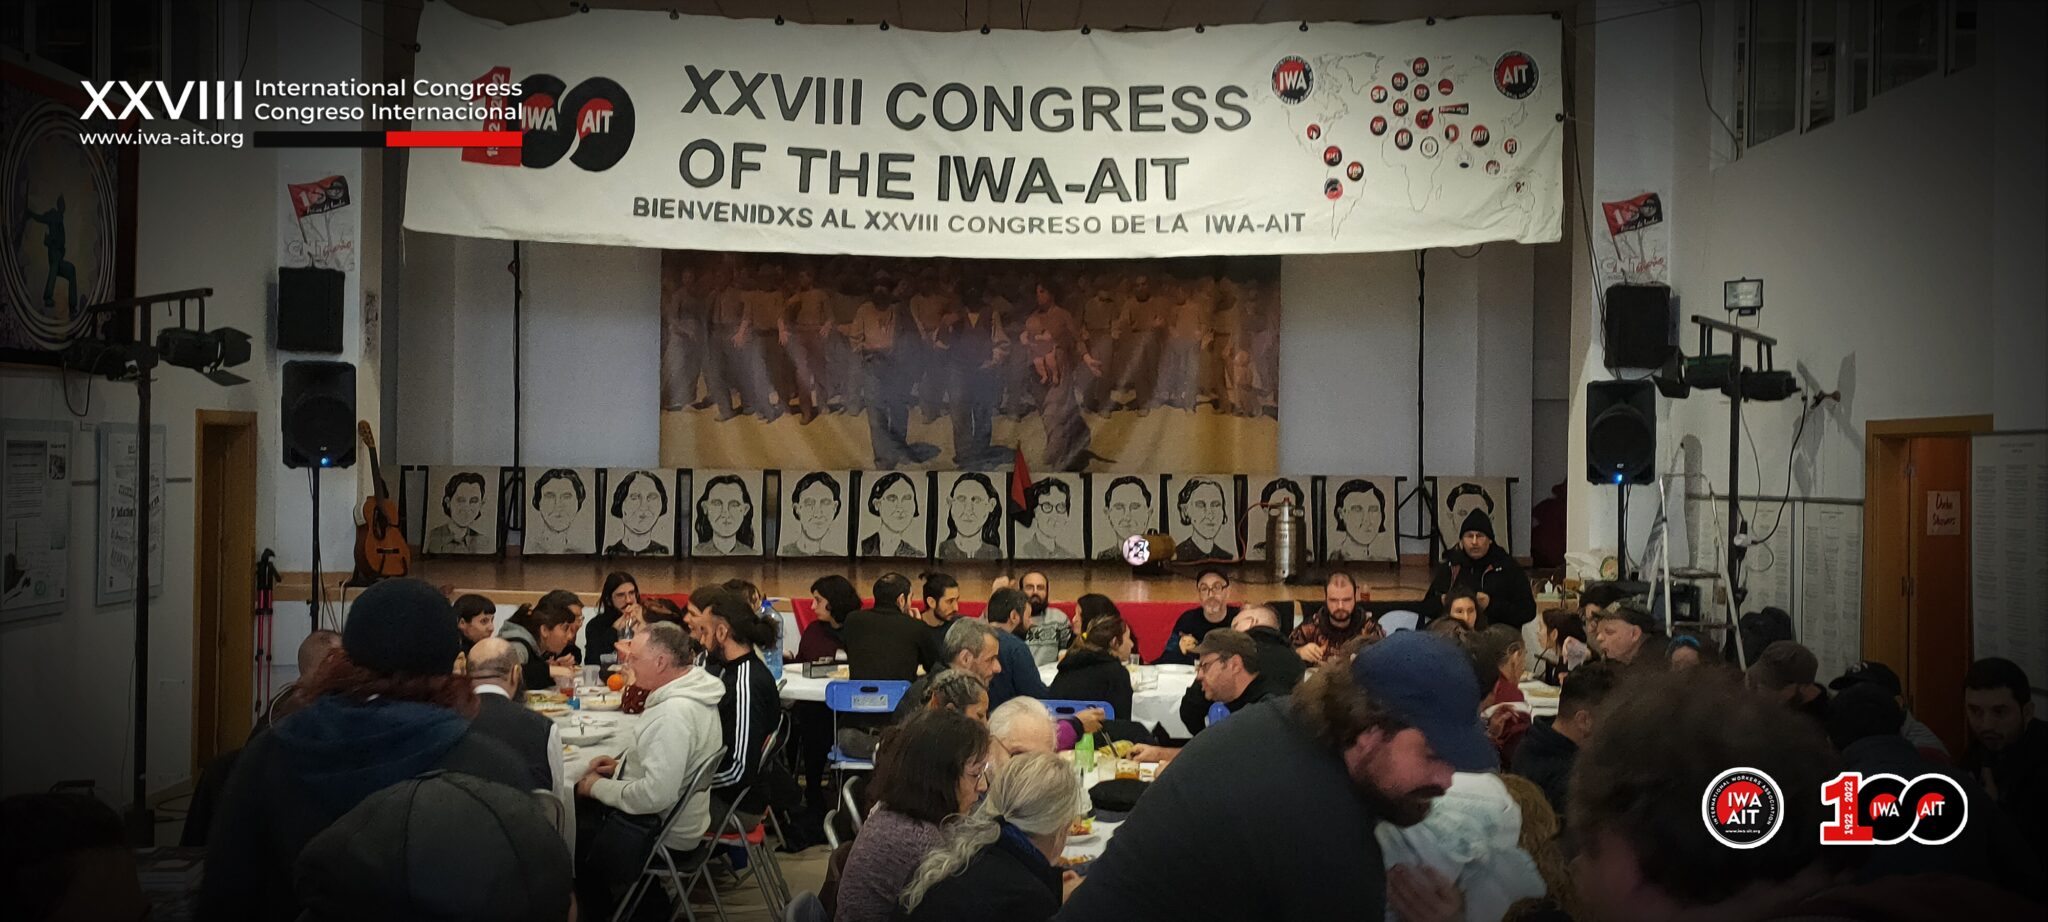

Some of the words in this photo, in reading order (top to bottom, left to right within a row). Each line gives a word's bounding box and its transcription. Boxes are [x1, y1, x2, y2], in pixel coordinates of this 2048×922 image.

[1279, 70, 1307, 91] IWA
[1502, 65, 1528, 84] AIT
[680, 65, 862, 125] XXVIII
[886, 82, 1252, 133] CONGRESS
[520, 105, 558, 132] IWA
[581, 109, 613, 133] AIT
[679, 138, 766, 189] OF
[787, 146, 914, 200] THE
[937, 155, 1190, 204] IWA-AIT
[633, 197, 813, 228] BIENVENIDXS
[821, 208, 856, 229] AL
[864, 209, 939, 232] XXVIII
[948, 215, 1101, 234] CONGRESO
[1111, 214, 1145, 234] DE
[1155, 214, 1189, 234] LA
[1205, 213, 1306, 234] IWA-AIT
